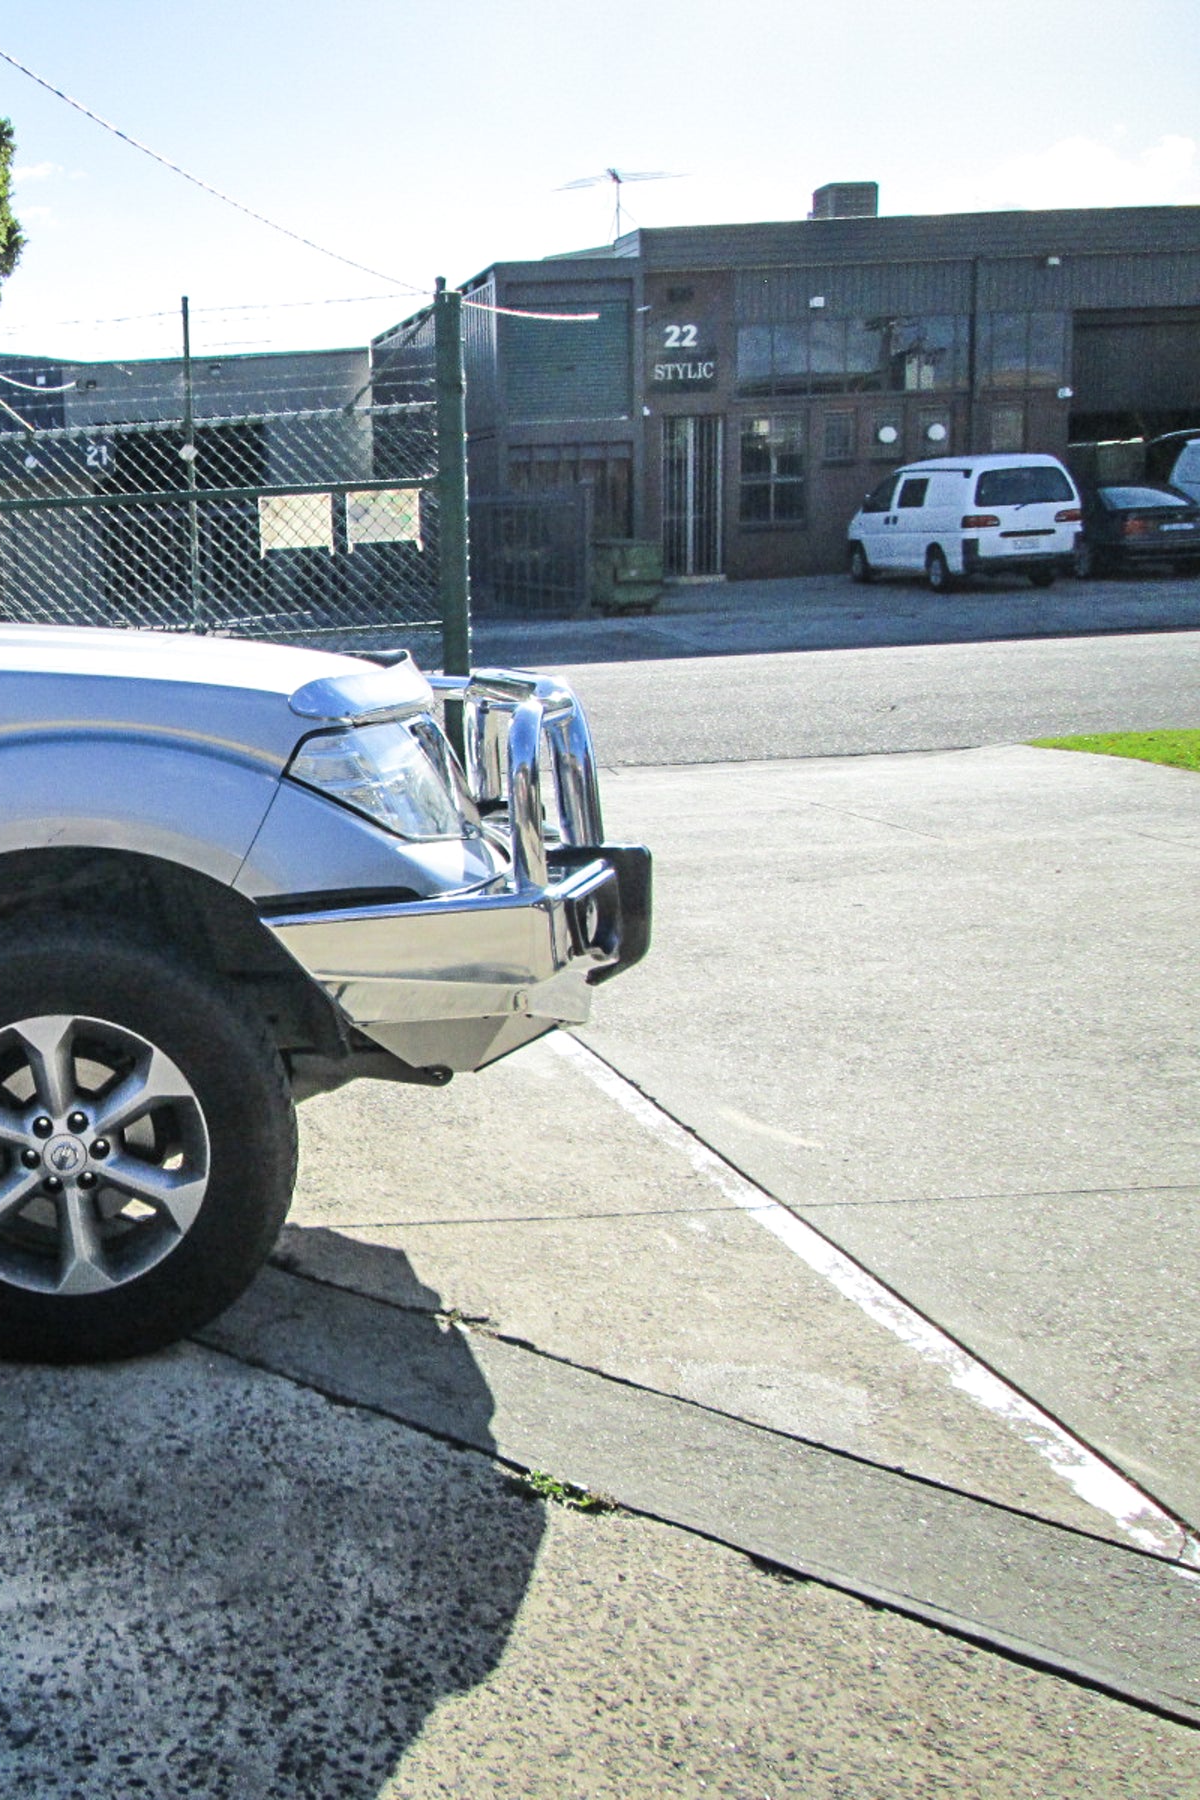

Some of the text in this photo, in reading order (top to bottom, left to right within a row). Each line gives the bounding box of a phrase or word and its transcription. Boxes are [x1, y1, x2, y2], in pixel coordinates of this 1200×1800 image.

[664, 324, 698, 348] 22
[653, 361, 714, 381] STYLIC
[86, 445, 108, 466] 21
